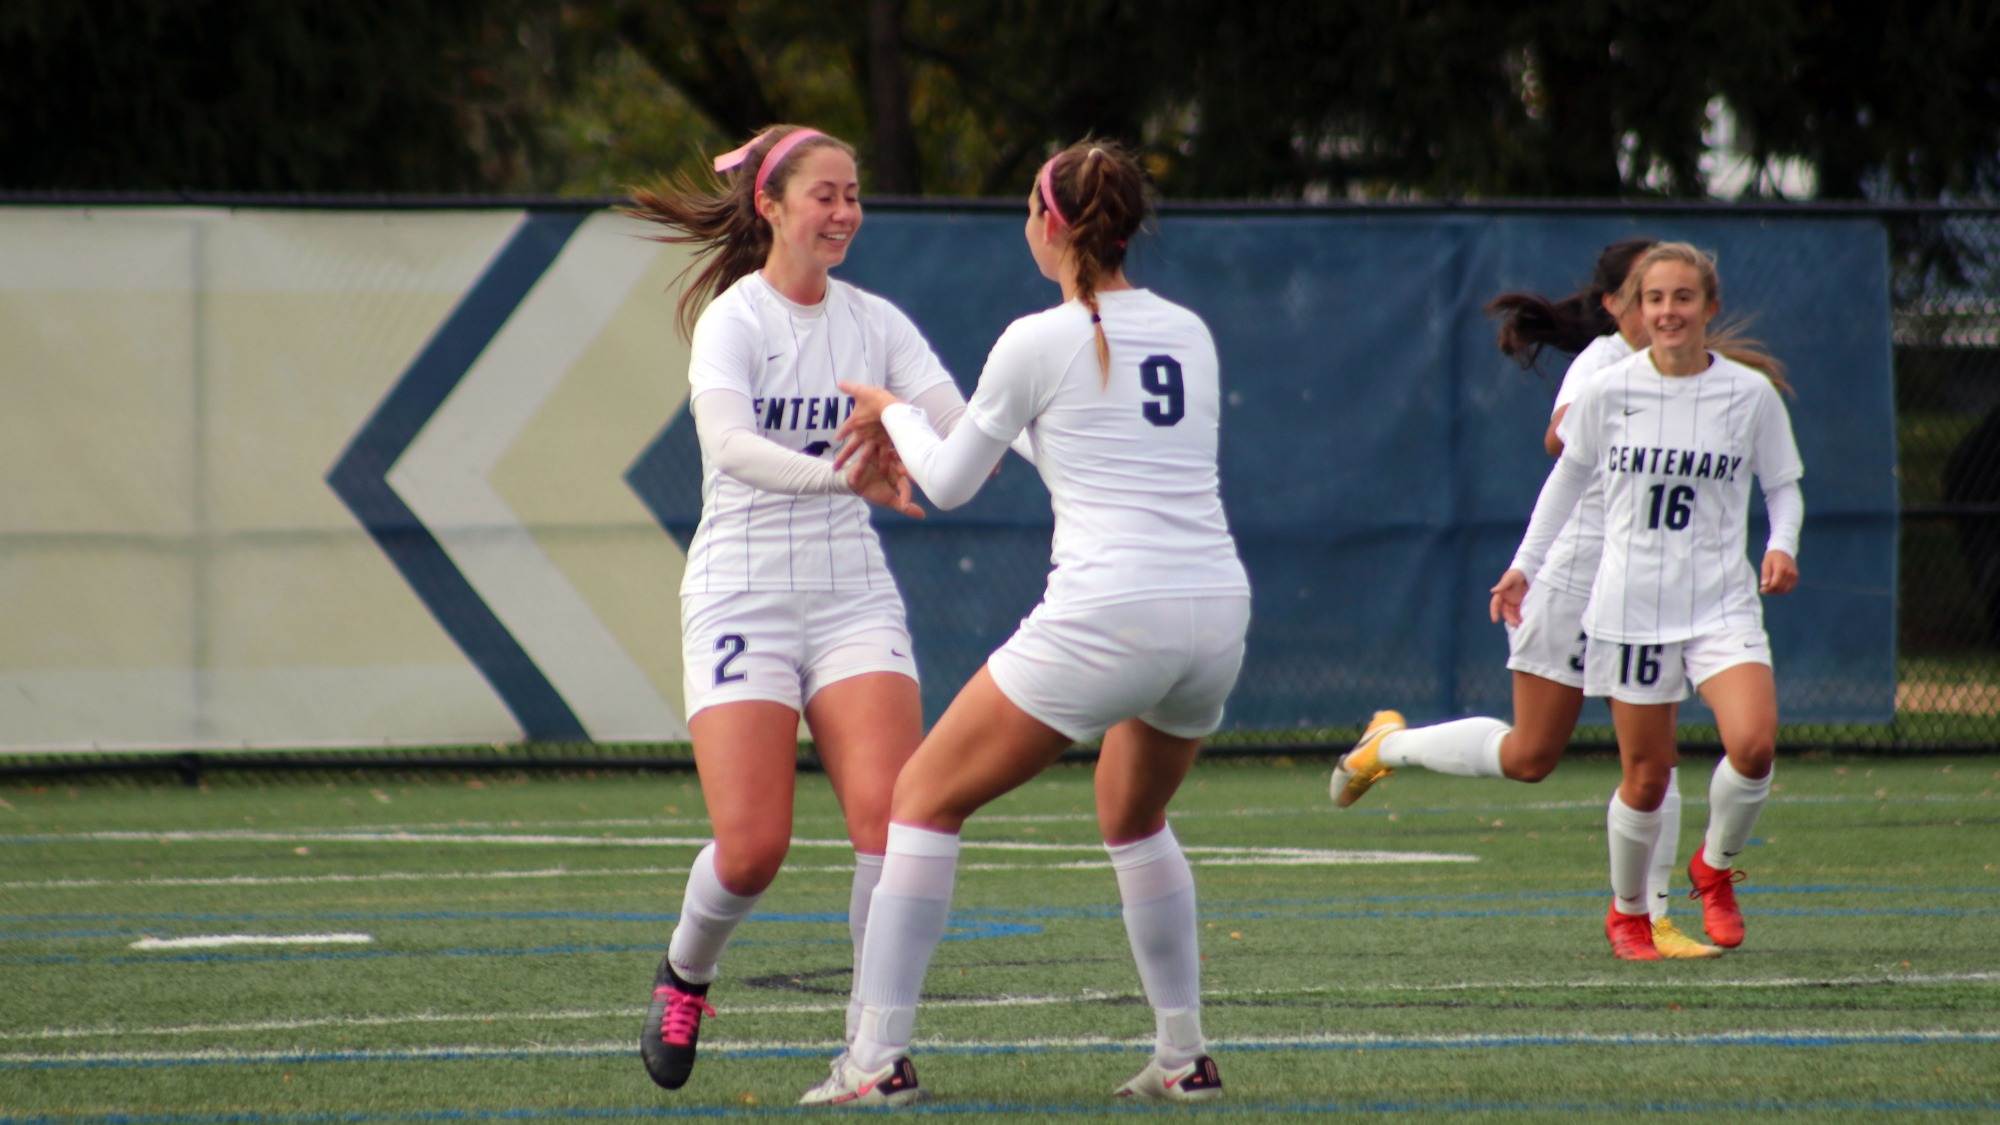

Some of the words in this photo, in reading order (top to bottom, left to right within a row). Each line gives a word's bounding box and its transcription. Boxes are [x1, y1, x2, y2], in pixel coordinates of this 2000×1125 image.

[1139, 354, 1185, 427] 9
[1608, 446, 1742, 482] CENTENARY
[1648, 483, 1695, 531] 16
[713, 633, 748, 687] 2
[1619, 643, 1662, 686] 16
